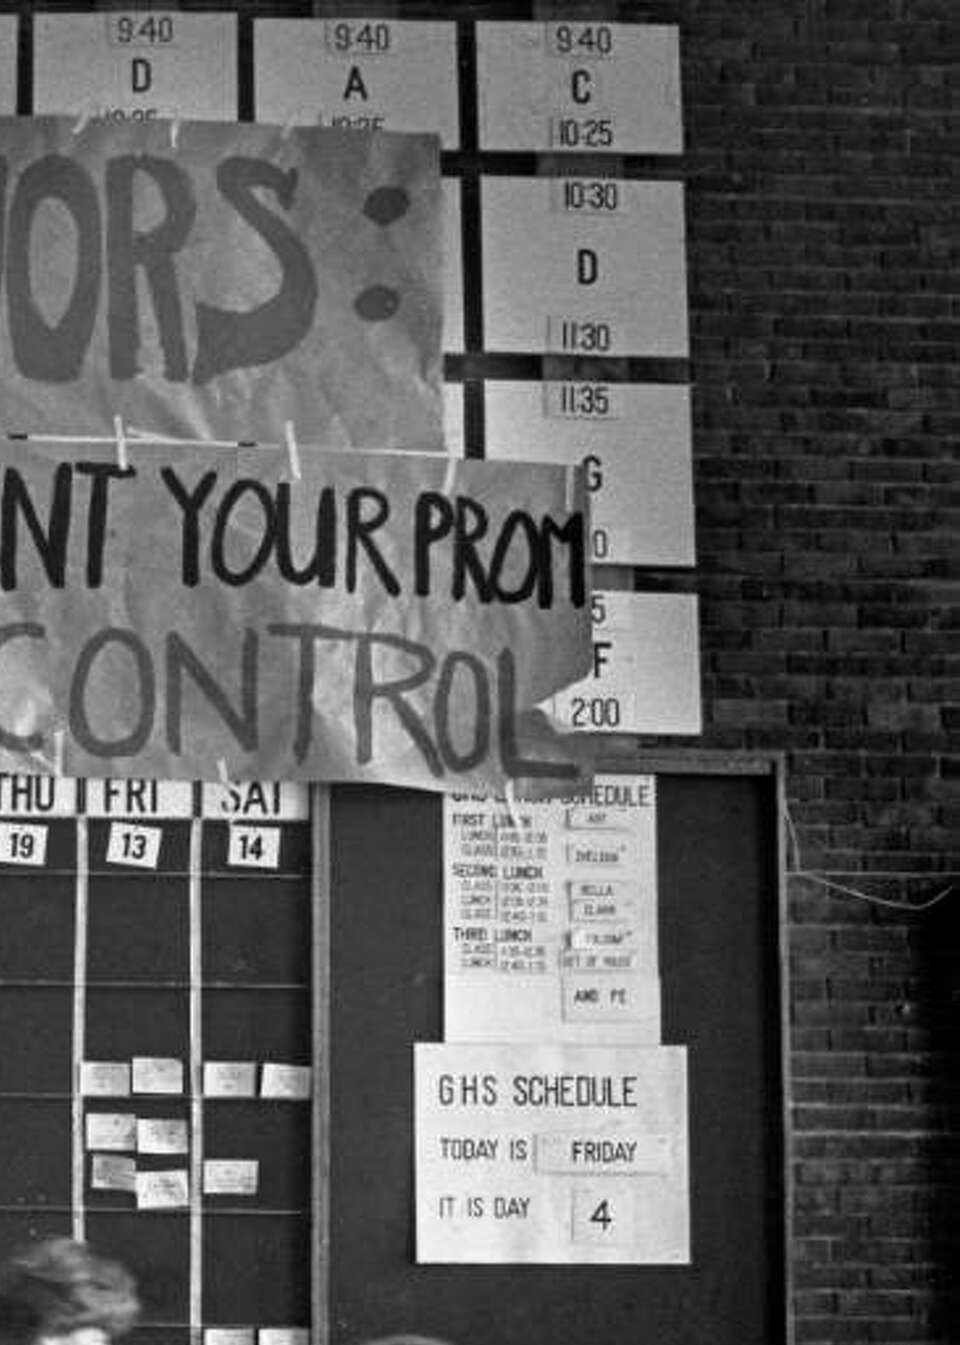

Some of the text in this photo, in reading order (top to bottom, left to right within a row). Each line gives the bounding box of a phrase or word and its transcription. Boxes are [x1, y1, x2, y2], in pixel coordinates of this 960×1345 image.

[118, 18, 173, 43] 9:40
[335, 24, 388, 51] 9:40
[132, 58, 151, 93] D
[343, 66, 368, 100] A
[572, 70, 591, 104] C
[578, 250, 597, 284] D
[583, 456, 601, 492] G
[160, 466, 401, 597] YOUR
[415, 491, 585, 609] PROM
[594, 642, 612, 679] F
[104, 779, 158, 813] FRI
[10, 832, 34, 859] 19
[122, 833, 147, 860] 13
[240, 834, 263, 861] 14
[503, 866, 543, 880] LUNCH
[494, 929, 533, 943] LUNCH
[439, 1074, 638, 1107] GHS SCHEDULE
[440, 1137, 638, 1163] TODAY IS FRIDAY
[439, 1196, 612, 1231] IT IS DAY 4
